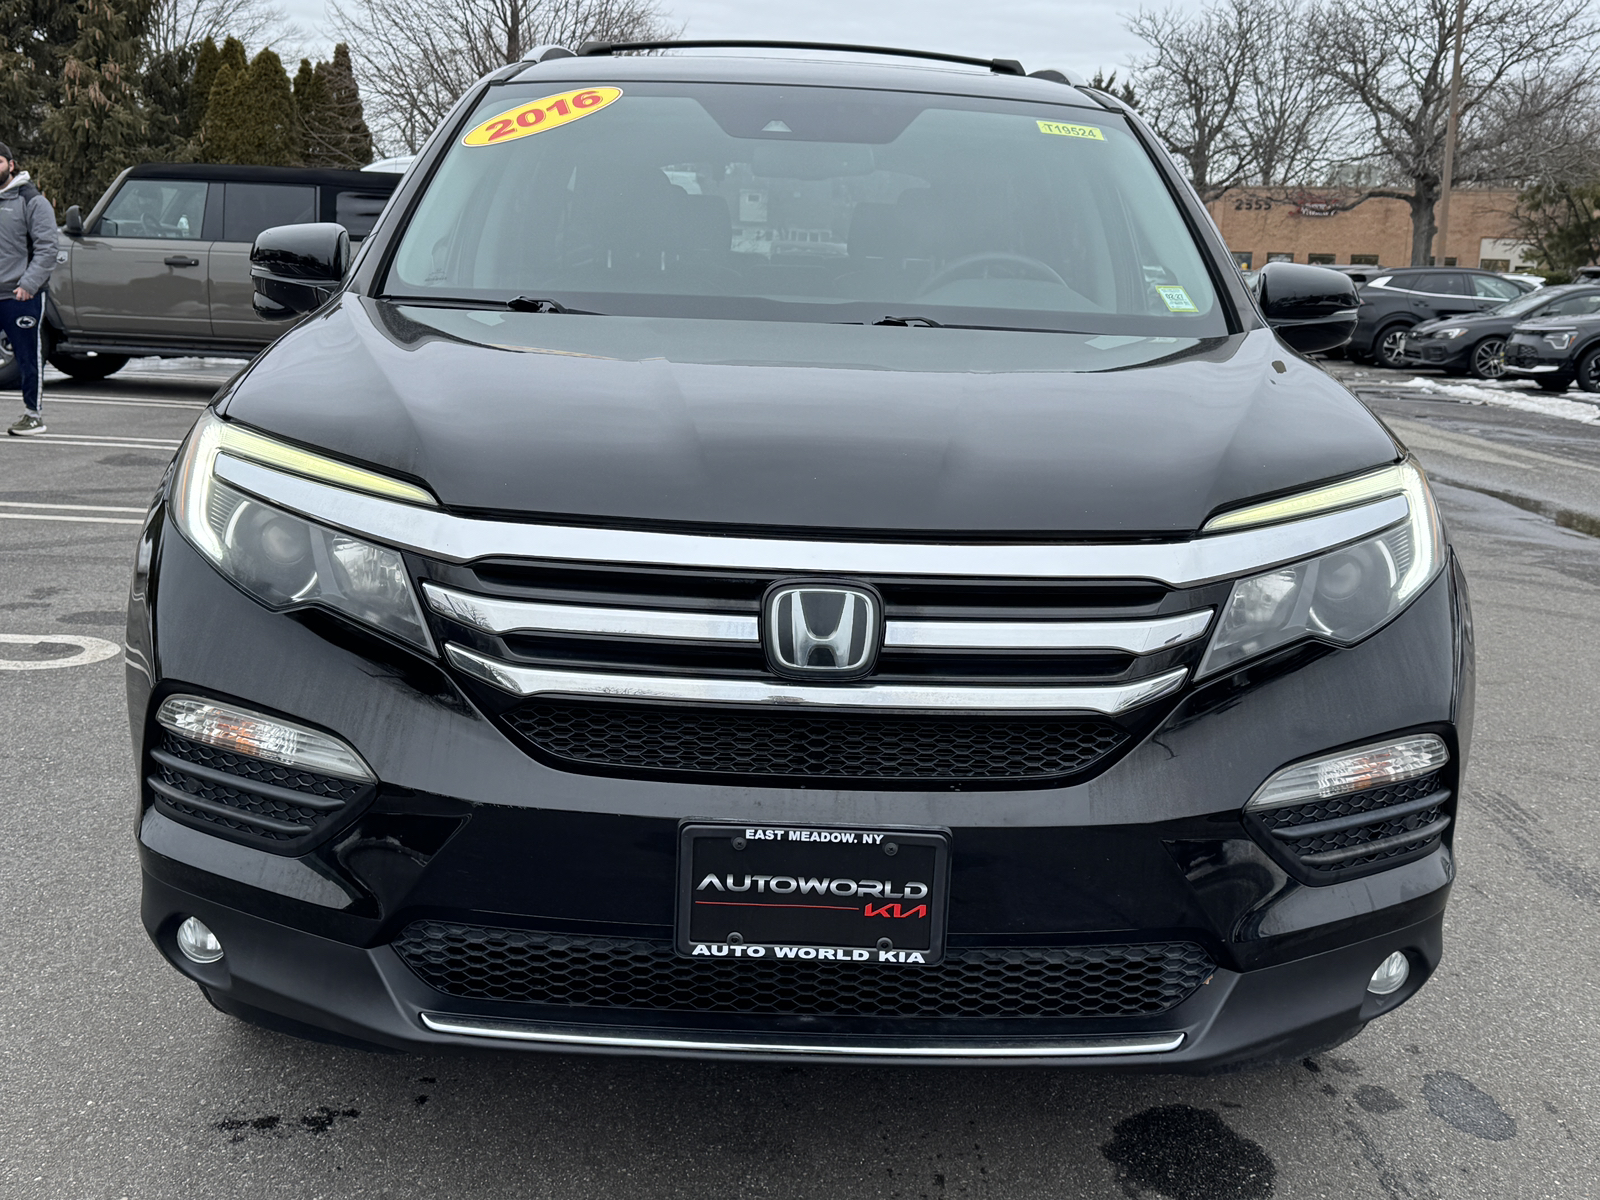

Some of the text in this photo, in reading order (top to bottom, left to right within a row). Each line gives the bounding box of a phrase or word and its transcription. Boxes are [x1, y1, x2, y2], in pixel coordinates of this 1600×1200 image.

[485, 91, 603, 142] 2016
[1043, 123, 1097, 138] T19524
[745, 829, 785, 840] EAST
[862, 834, 884, 844] NY
[696, 873, 928, 899] AUTOWORLD
[692, 944, 926, 963] AUTO WORLD KIA
